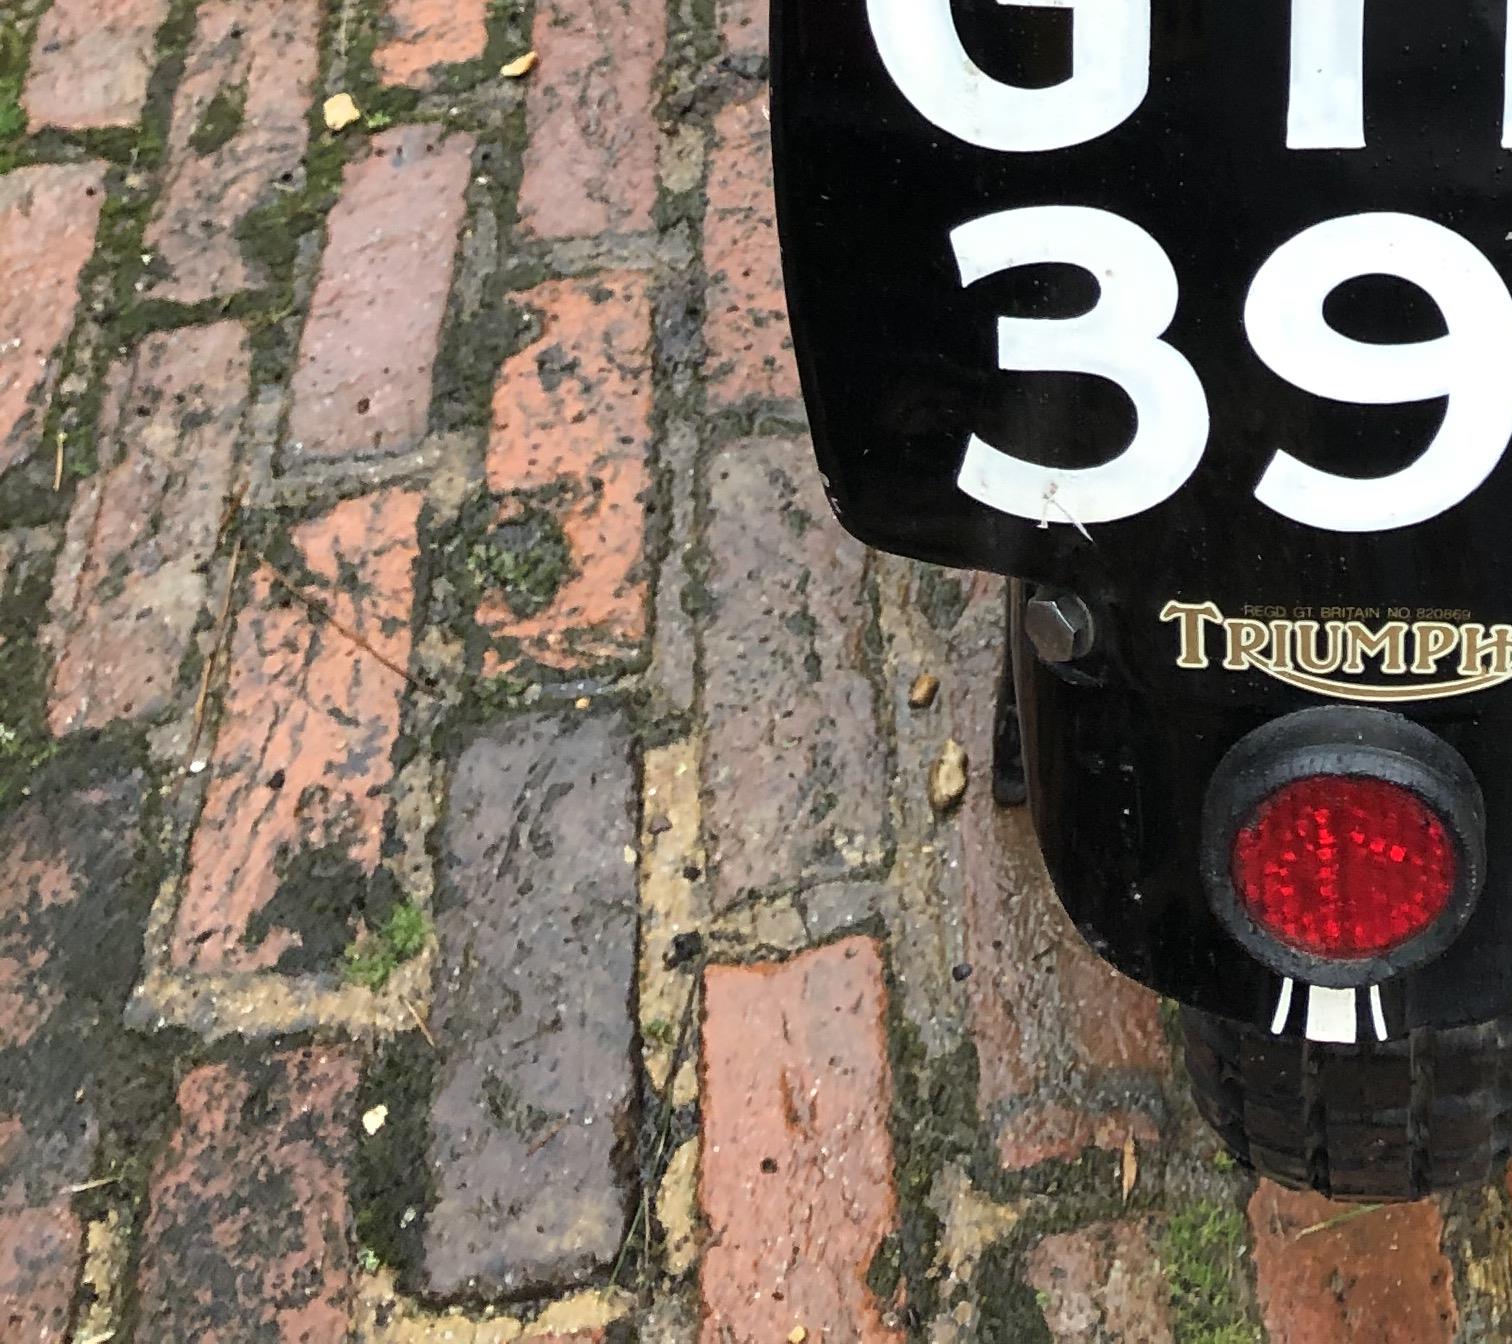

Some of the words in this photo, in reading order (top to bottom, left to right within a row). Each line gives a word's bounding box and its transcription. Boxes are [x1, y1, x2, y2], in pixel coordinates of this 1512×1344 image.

[1243, 605, 1287, 618] REGD
[1293, 606, 1313, 618] GT
[1320, 606, 1380, 619] BRITAIN
